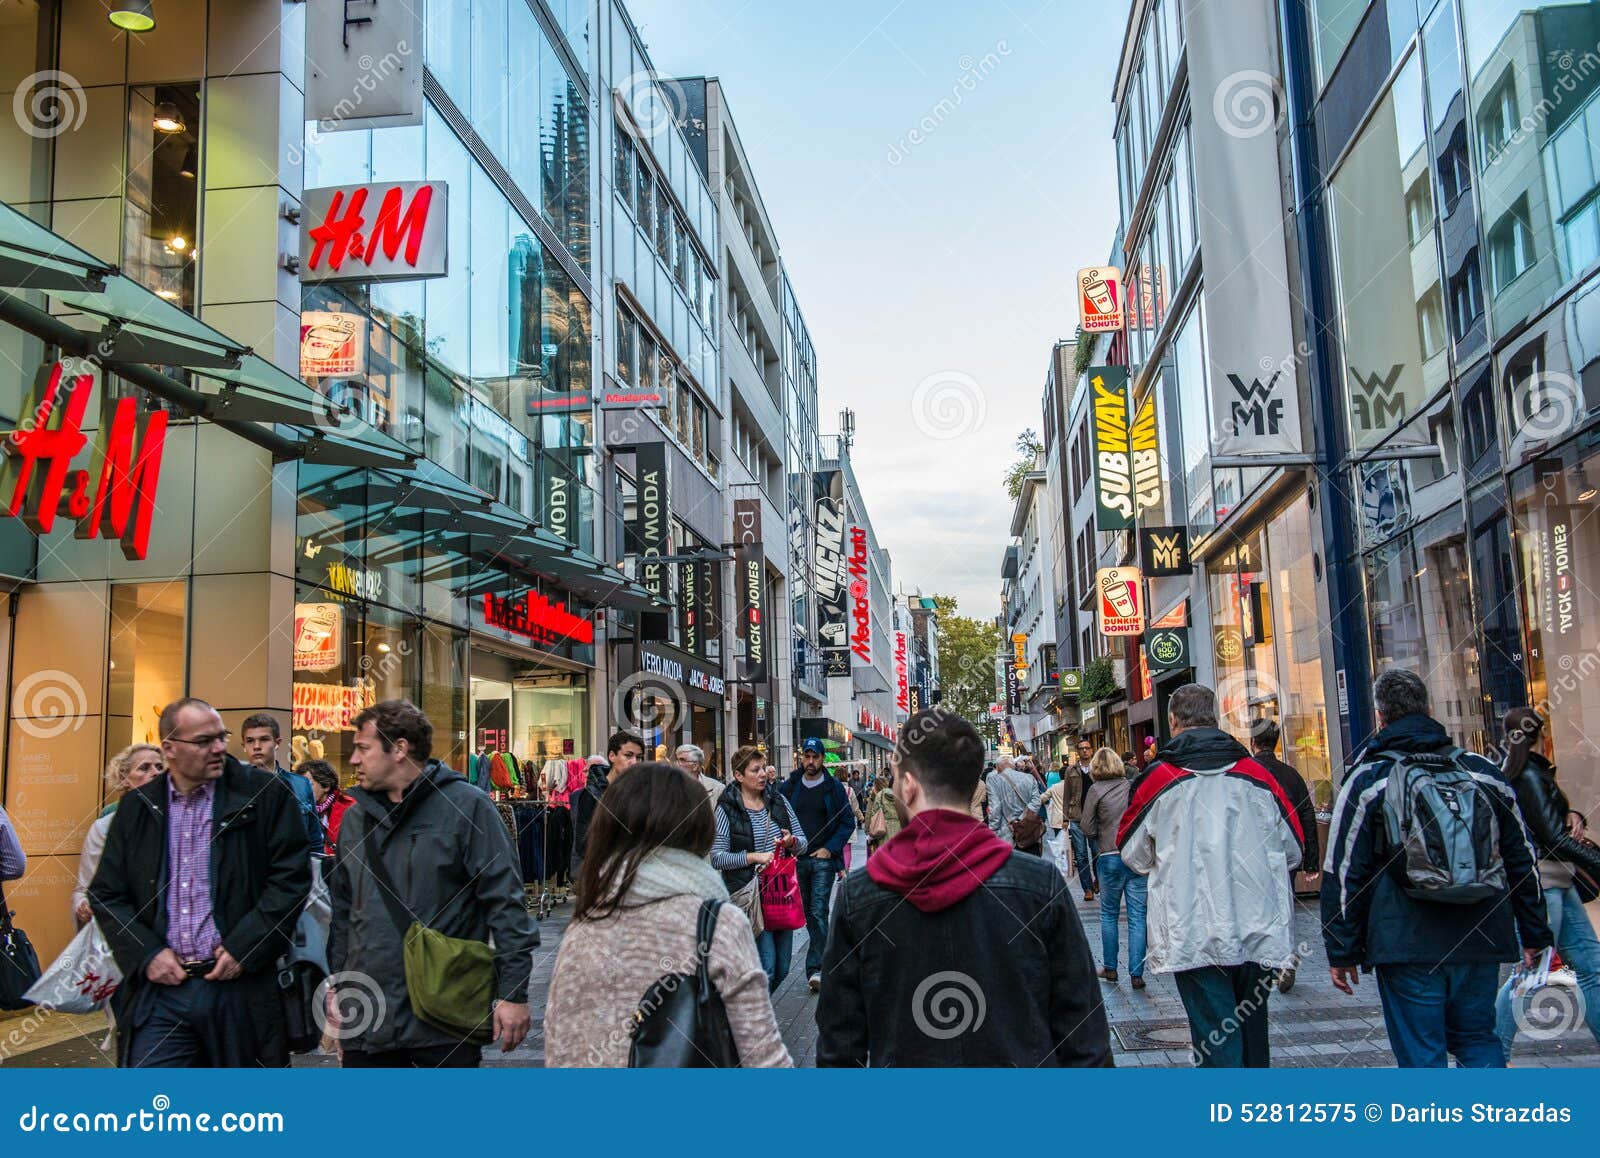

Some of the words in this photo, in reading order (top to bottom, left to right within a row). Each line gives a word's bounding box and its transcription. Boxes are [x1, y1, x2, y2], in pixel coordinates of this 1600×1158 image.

[308, 185, 432, 271] H&M
[1085, 313, 1121, 321] DUNKIN'
[1085, 320, 1119, 328] DONUTS
[1227, 371, 1284, 437] WMF
[10, 361, 168, 560] H&M
[644, 470, 660, 545] MODA
[848, 525, 868, 581] Markt
[1150, 533, 1181, 569] WMF
[748, 560, 760, 609] JONES
[750, 622, 762, 664] JACK
[849, 598, 871, 663] Media
[1104, 617, 1141, 625] DUNKIN'
[1104, 624, 1140, 632] DONUTS
[640, 651, 662, 675] VERO
[662, 661, 683, 683] MODA
[689, 669, 704, 690] JACK
[708, 675, 725, 696] JONES
